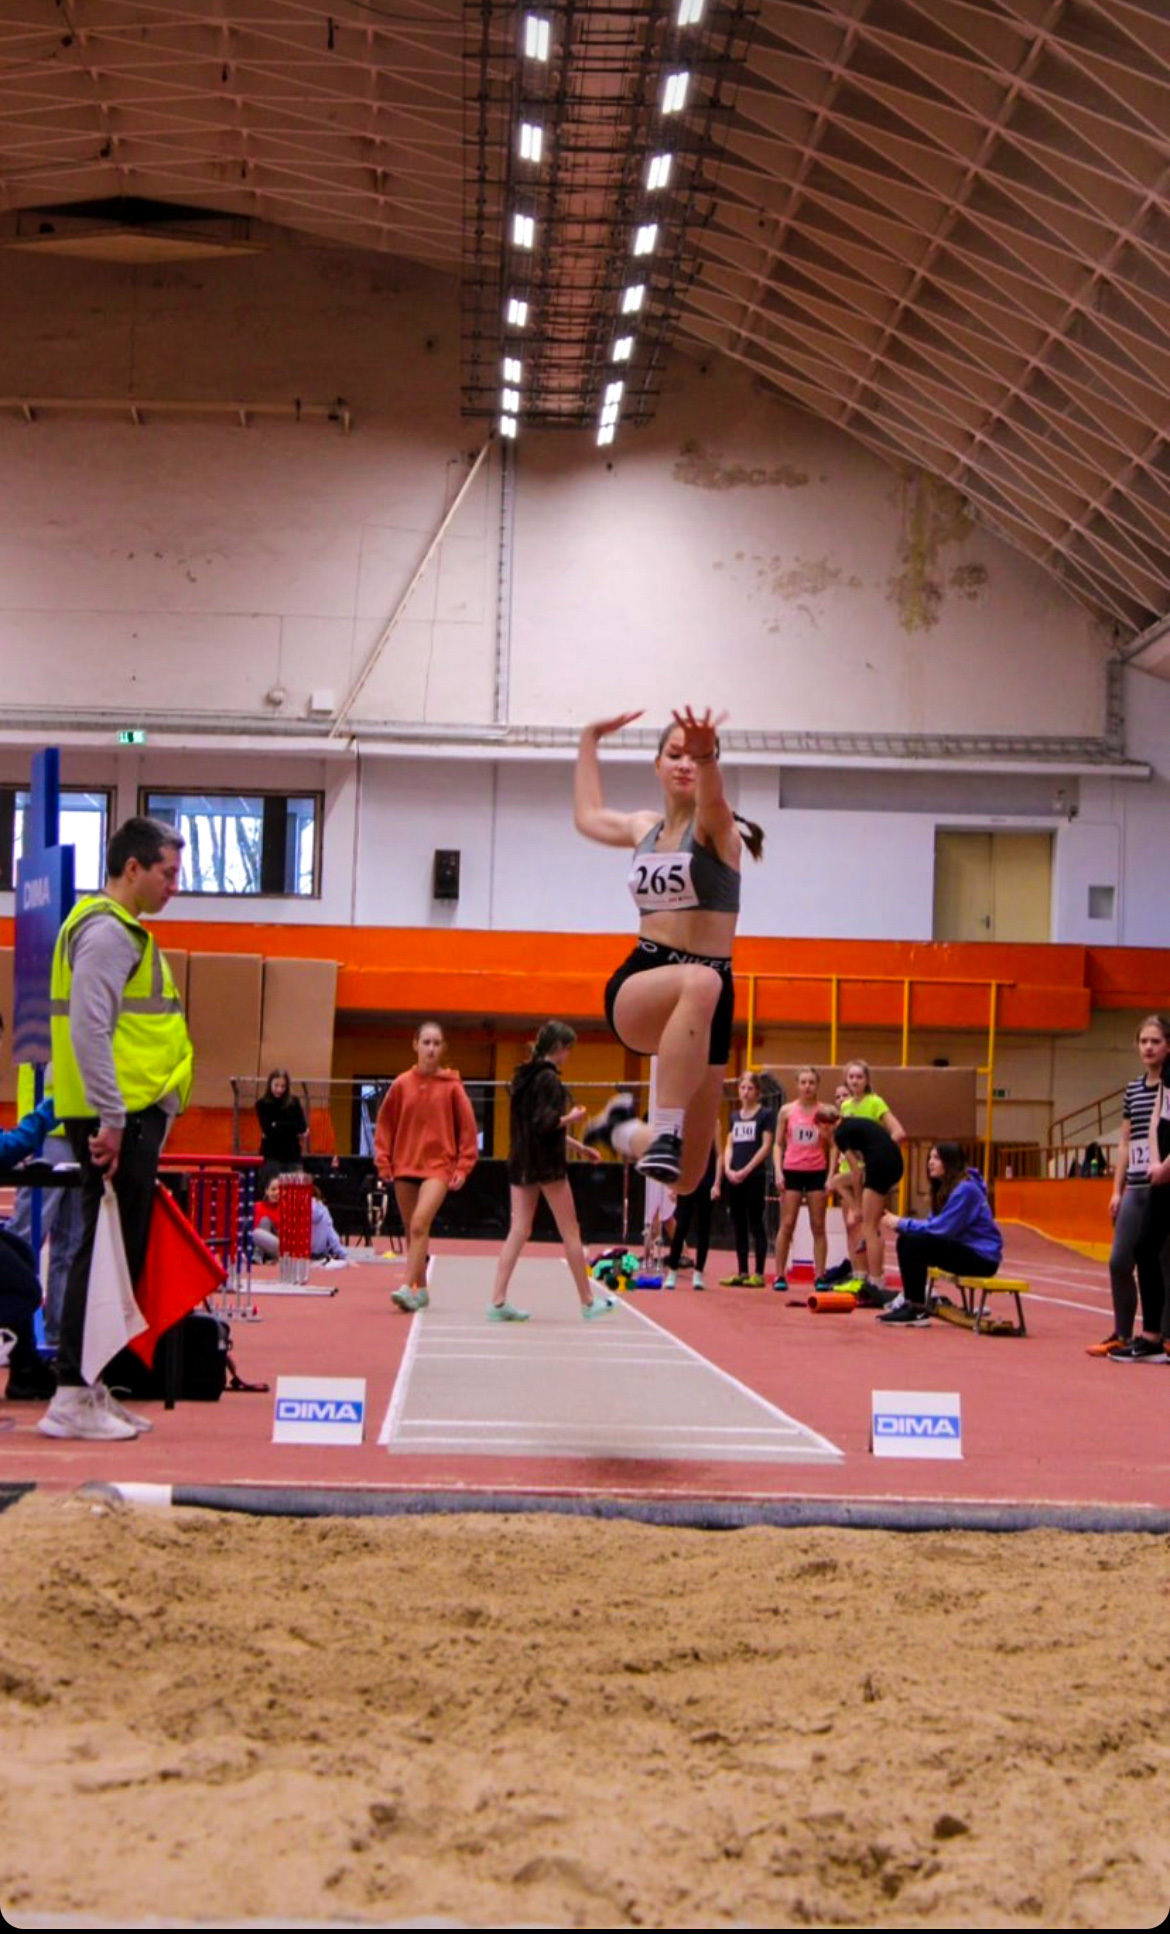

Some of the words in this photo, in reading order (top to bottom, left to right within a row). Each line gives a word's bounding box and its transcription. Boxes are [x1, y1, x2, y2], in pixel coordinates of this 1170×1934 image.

[636, 865, 685, 895] 265
[23, 877, 50, 911] DIMA
[279, 1402, 358, 1421] DIMA
[878, 1417, 956, 1435] DIMA
